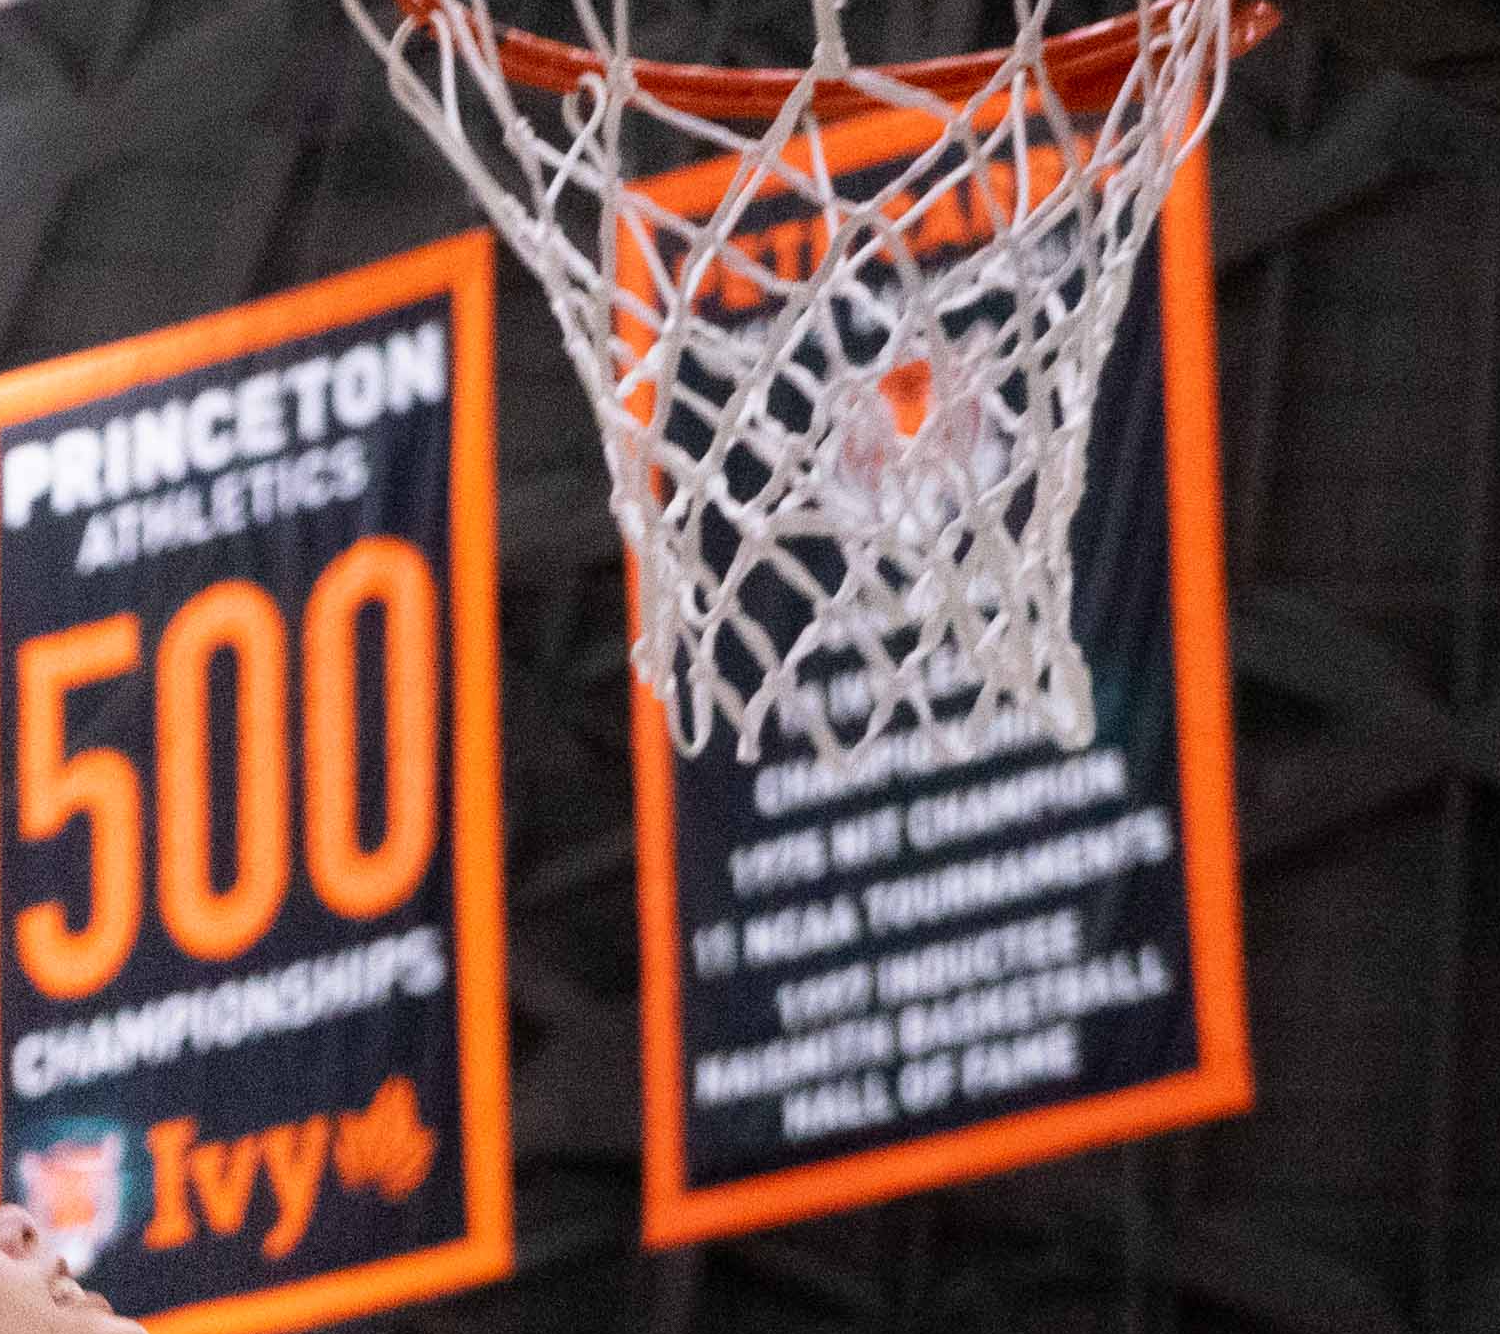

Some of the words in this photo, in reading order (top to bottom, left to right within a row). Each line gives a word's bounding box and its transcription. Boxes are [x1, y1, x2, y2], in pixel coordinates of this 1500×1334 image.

[2, 323, 445, 528] PRINCETON
[76, 438, 371, 572] ATHLETICS
[15, 536, 439, 999] 500
[908, 746, 1131, 852] CHAMPION
[743, 893, 862, 968] NCAA
[862, 805, 1176, 939] TOURNAMENTS
[877, 907, 1085, 1004] INDUCTEE
[9, 927, 447, 1102] CHAMPIONSHIPS
[898, 944, 1176, 1059] BASKETBALL
[783, 1069, 900, 1145] HALL
[899, 1053, 957, 1115] OF
[963, 1023, 1085, 1100] FAME
[143, 1109, 333, 1261] Ivy
